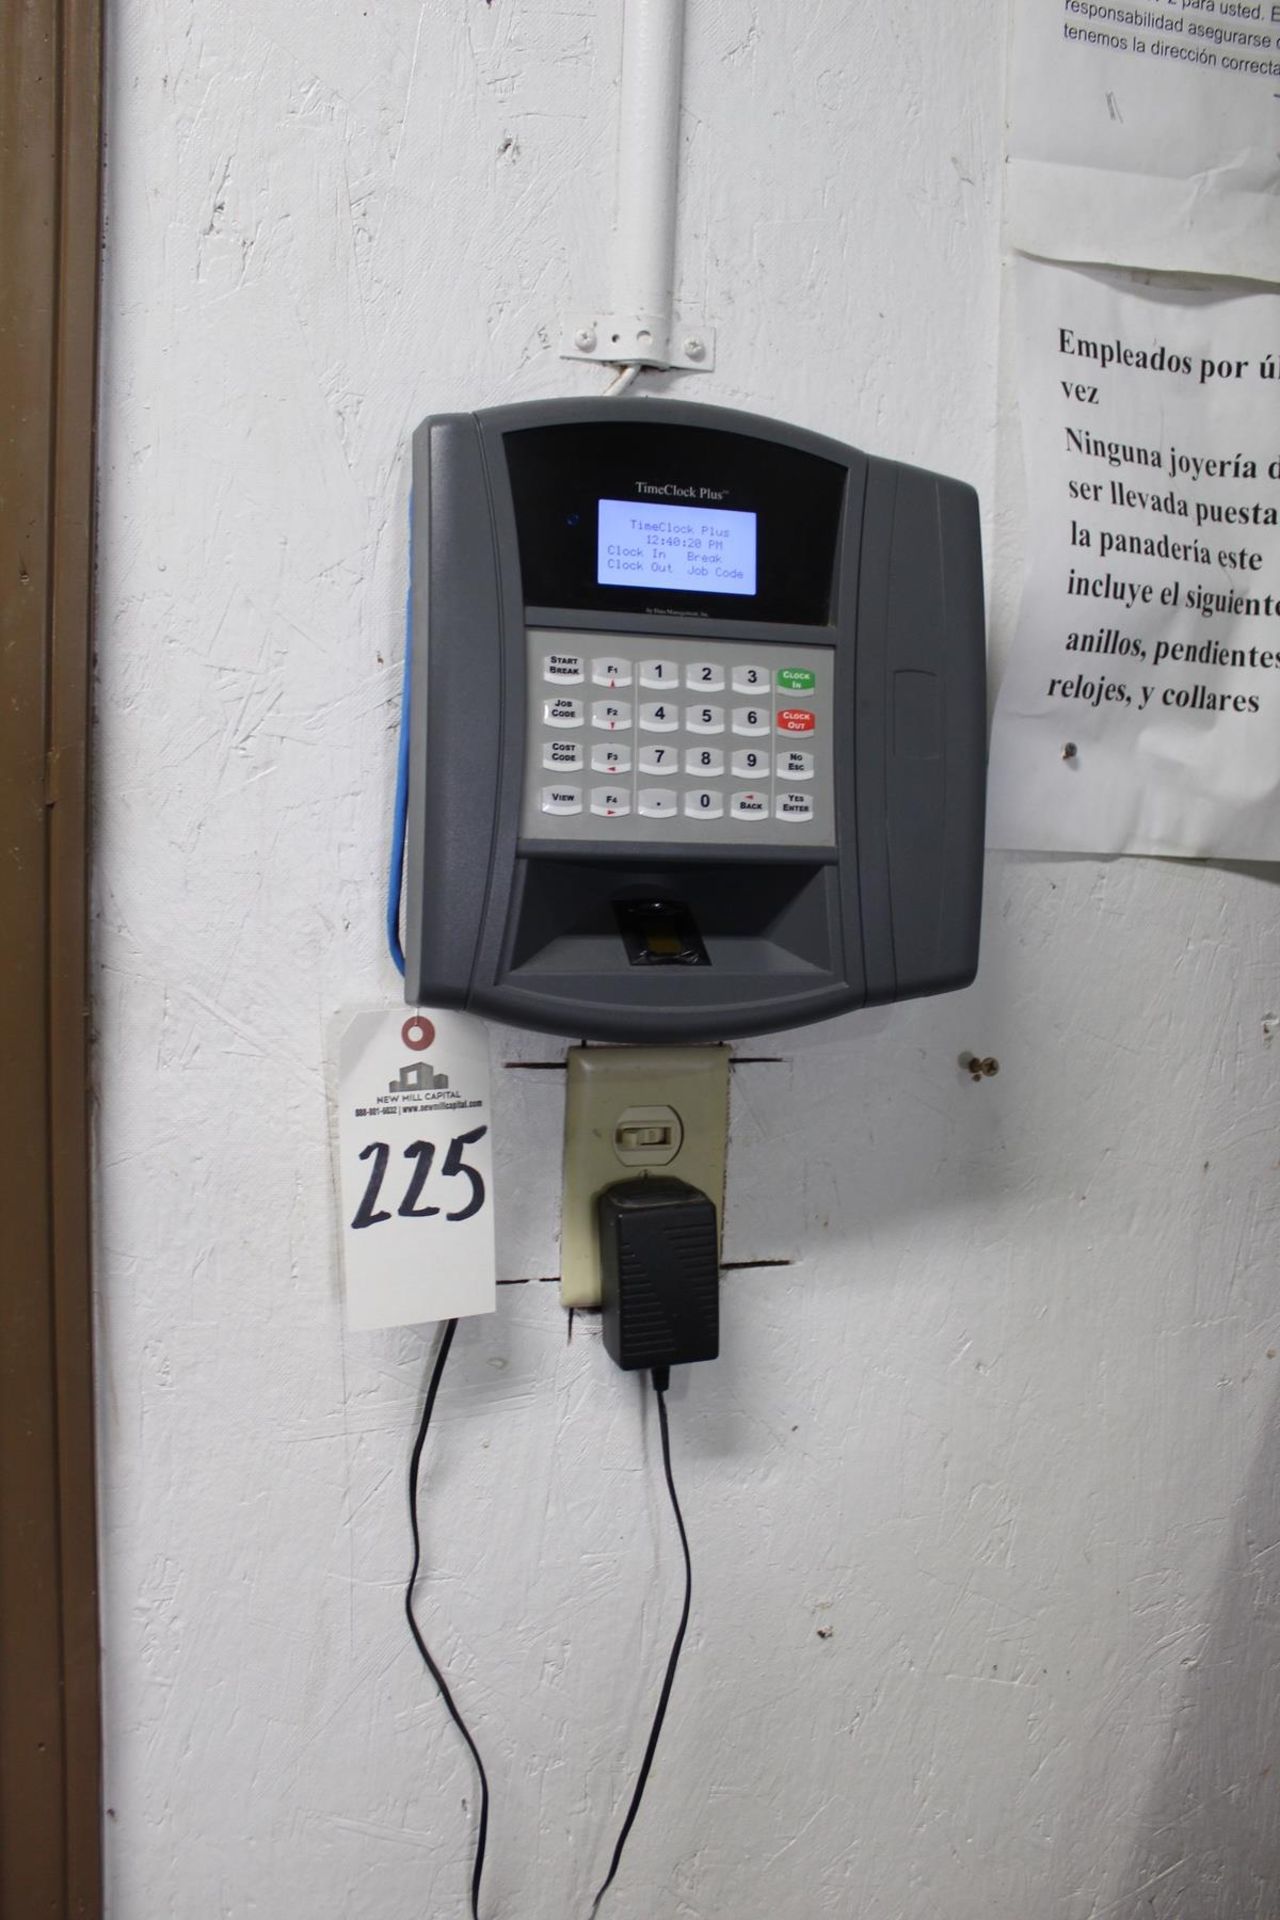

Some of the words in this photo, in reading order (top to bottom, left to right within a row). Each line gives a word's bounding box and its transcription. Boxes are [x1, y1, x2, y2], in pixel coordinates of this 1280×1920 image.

[1220, 3, 1265, 21] usted.
[1065, 0, 1183, 32] responsabilidad
[1188, 22, 1271, 48] asegurarse
[1063, 23, 1127, 50] tenemos
[1132, 36, 1146, 53] la
[1151, 40, 1217, 67] dirección
[1058, 328, 1193, 375] Empleados
[1199, 358, 1249, 384] por
[1060, 380, 1099, 405] vez
[1065, 427, 1162, 467] Ninguna
[1168, 447, 1257, 481] joyería
[635, 481, 697, 498] TimeClock
[1069, 479, 1103, 502] ser
[1110, 481, 1188, 517] llevada
[1196, 501, 1278, 526] puesta
[630, 519, 695, 534] TimeClock
[701, 526, 730, 538] Plus
[646, 535, 702, 549] 12:40:20
[708, 540, 723, 550] PM
[1071, 520, 1091, 547] la
[1100, 530, 1211, 565] panadería
[1218, 548, 1263, 571] este
[607, 545, 643, 558] Clock
[652, 549, 666, 559] In
[687, 551, 722, 563] Break
[607, 559, 643, 571] Clock
[651, 562, 673, 574] Out
[687, 566, 709, 577] Job
[715, 568, 744, 580] Code
[1067, 568, 1153, 609] incluye
[1160, 581, 1180, 607] el
[1065, 628, 1146, 661] anillos,
[654, 665, 663, 678] 1
[701, 667, 712, 681] 2
[747, 669, 758, 684] 3
[1047, 674, 1132, 707] relojes,
[1138, 685, 1155, 710] y
[1162, 685, 1260, 713] collares
[654, 706, 665, 720] 4
[701, 709, 712, 723] 5
[747, 710, 758, 725] 6
[654, 750, 665, 763] 7
[701, 751, 711, 765] 8
[746, 753, 757, 768] 9
[700, 793, 710, 808] 0
[376, 1095, 399, 1104] NEW
[402, 1093, 422, 1102] MILL
[424, 1090, 461, 1101] CAPITAL
[351, 1125, 488, 1230] 225
